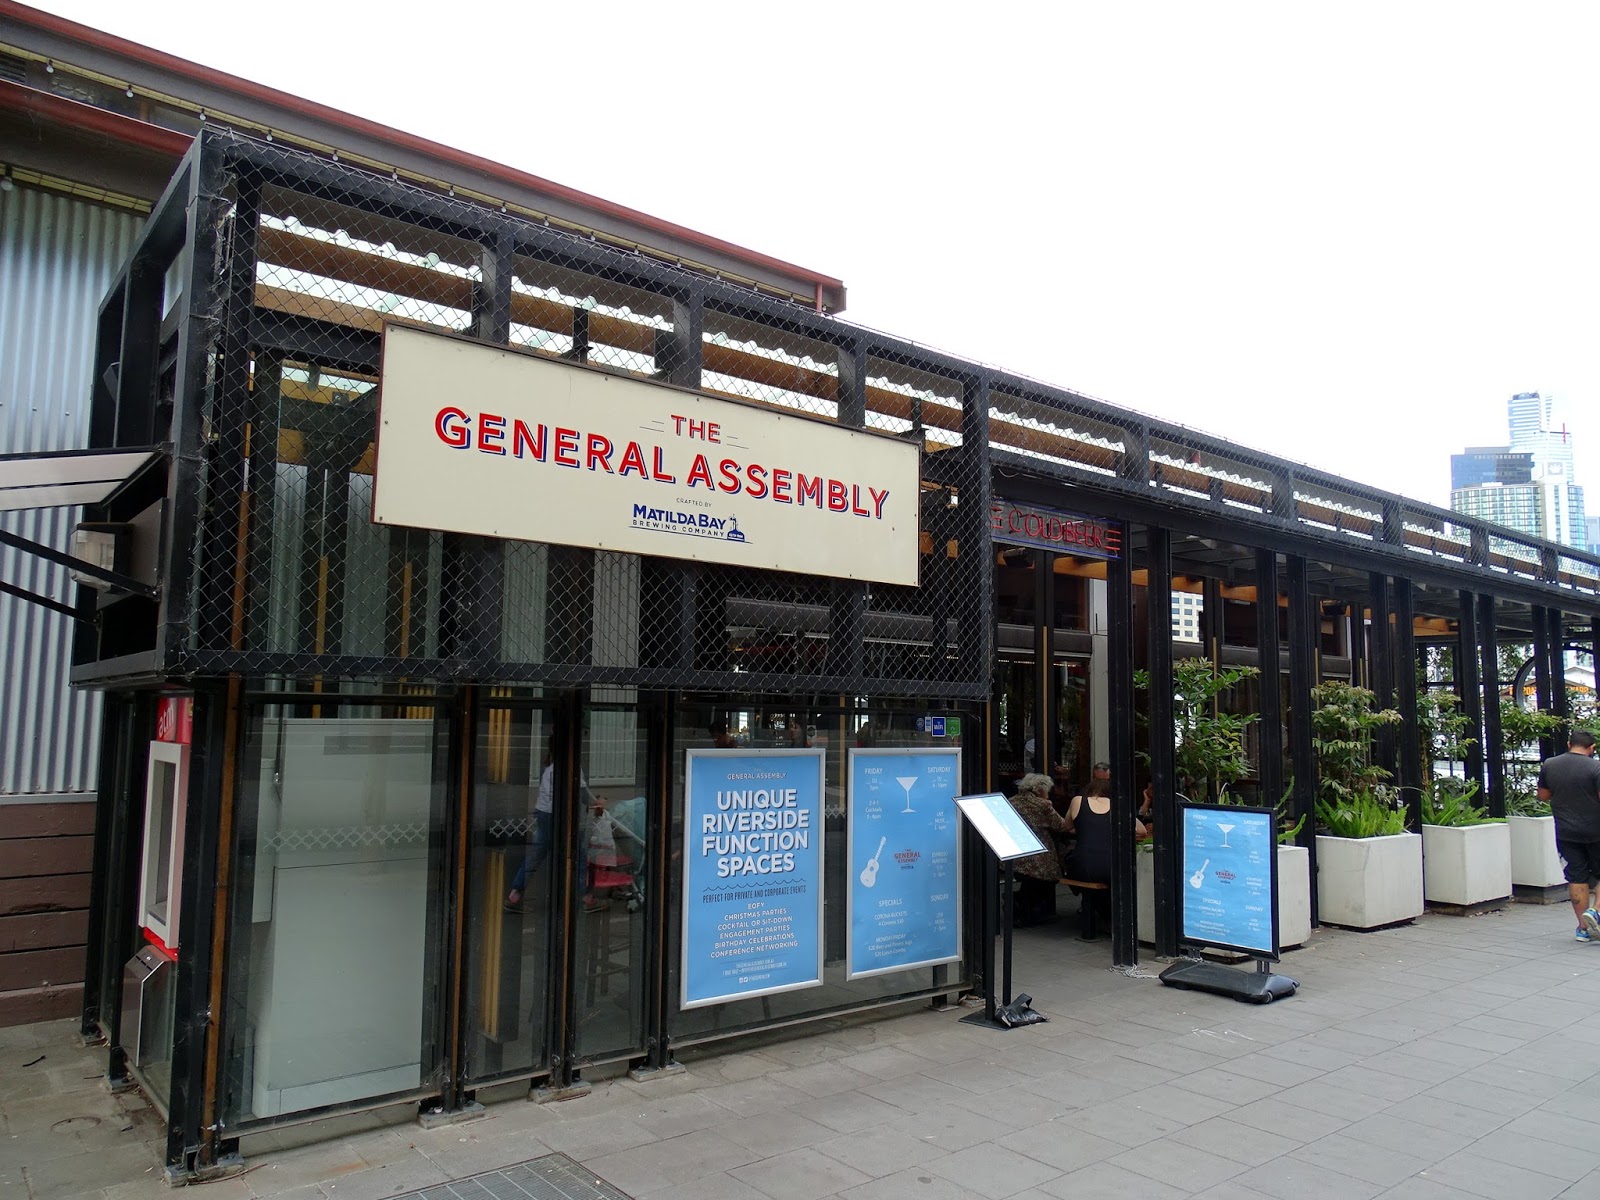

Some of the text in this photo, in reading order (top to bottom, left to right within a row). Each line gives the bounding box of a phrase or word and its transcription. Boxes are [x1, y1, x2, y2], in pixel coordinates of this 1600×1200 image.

[671, 414, 722, 444] THE
[434, 406, 891, 520] GENERAL ASSEMBLY
[676, 497, 703, 507] CRAFTED
[632, 503, 727, 530] MATILDA BAY
[1008, 509, 1063, 540] COLD
[632, 519, 677, 531] BREWING
[682, 526, 725, 537] COMPANY
[158, 703, 174, 738] atm
[864, 767, 883, 775] FRIDAY
[717, 788, 798, 811] UNIQUE
[702, 809, 810, 834] RIVERSIDE
[702, 830, 809, 857] FUNCTION
[894, 851, 921, 860] GENERAL
[717, 852, 796, 878] SPACES
[702, 885, 807, 903] PERFECT FOR PRIVATE AND CORPORATE EVENTS
[878, 898, 903, 907] SPECIALS
[724, 908, 787, 921] CHRISTMAS PARTIES
[747, 902, 765, 910] EOFY
[718, 916, 793, 931] COCKTAIL OR SIT-DOWN
[720, 924, 791, 939] ENGAGEMENT PARTIES
[710, 940, 799, 959] CONFERENCE NETWORKING
[714, 932, 795, 949] BIRTHDAY CELEBRATIONS
